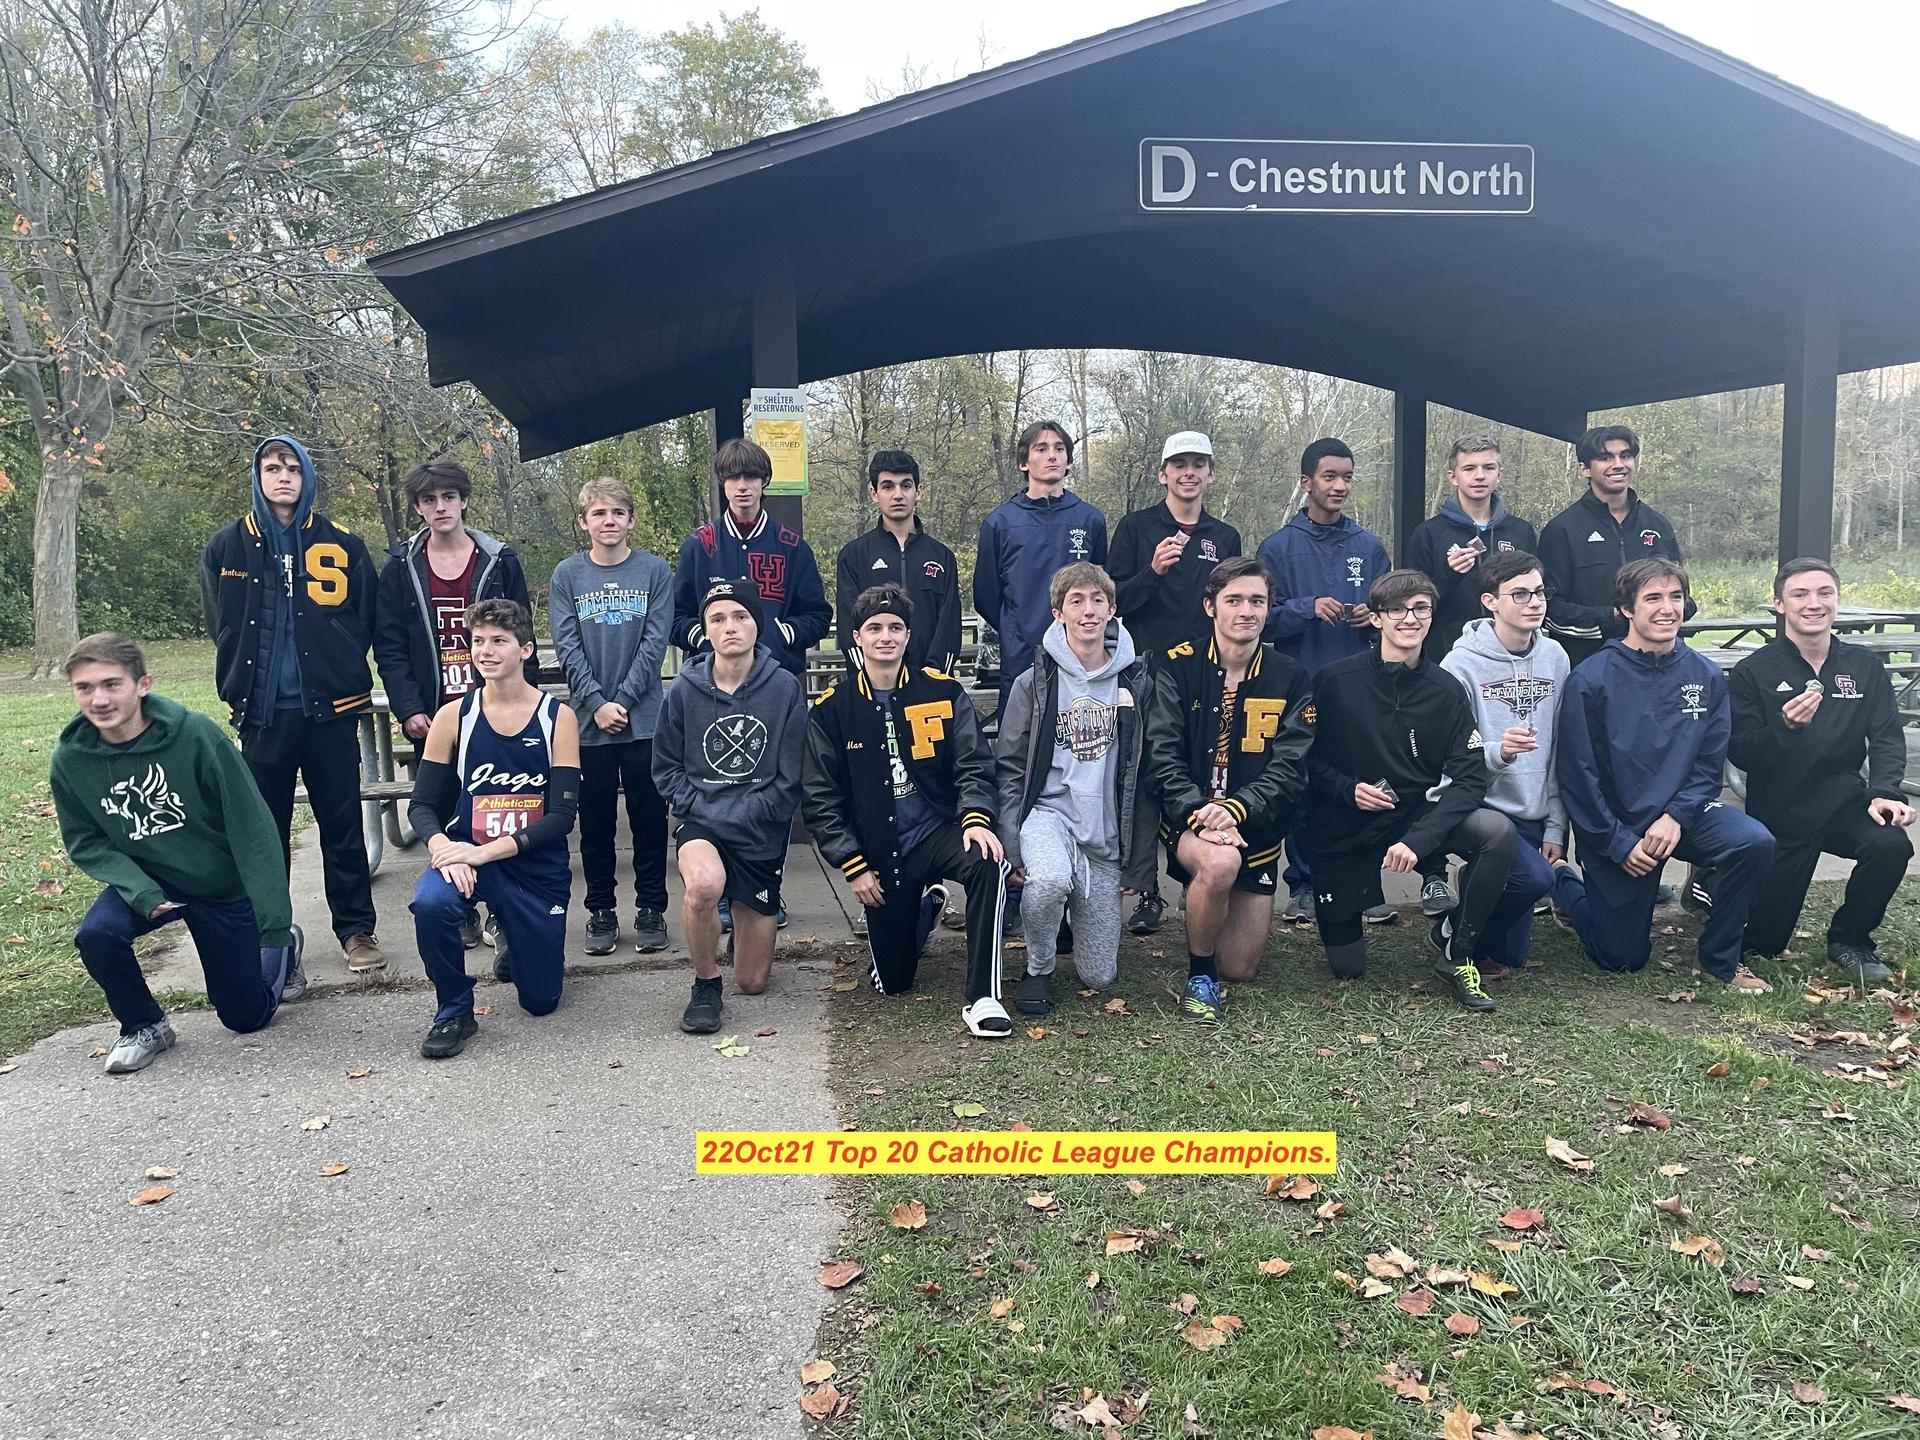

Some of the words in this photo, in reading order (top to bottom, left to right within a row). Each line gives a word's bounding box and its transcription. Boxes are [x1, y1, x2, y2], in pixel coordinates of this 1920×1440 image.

[1151, 145, 1196, 203] D
[1229, 157, 1406, 195] Chestnut
[1418, 161, 1524, 196] North
[753, 404, 804, 413] RESERVATIONS
[764, 396, 794, 404] SHELTER
[760, 440, 800, 448] RESERVED
[305, 543, 348, 606] S
[904, 700, 954, 760] F
[1240, 698, 1287, 753] F
[467, 763, 547, 792] Jags
[475, 797, 524, 810] Athletic
[486, 812, 528, 838] 541
